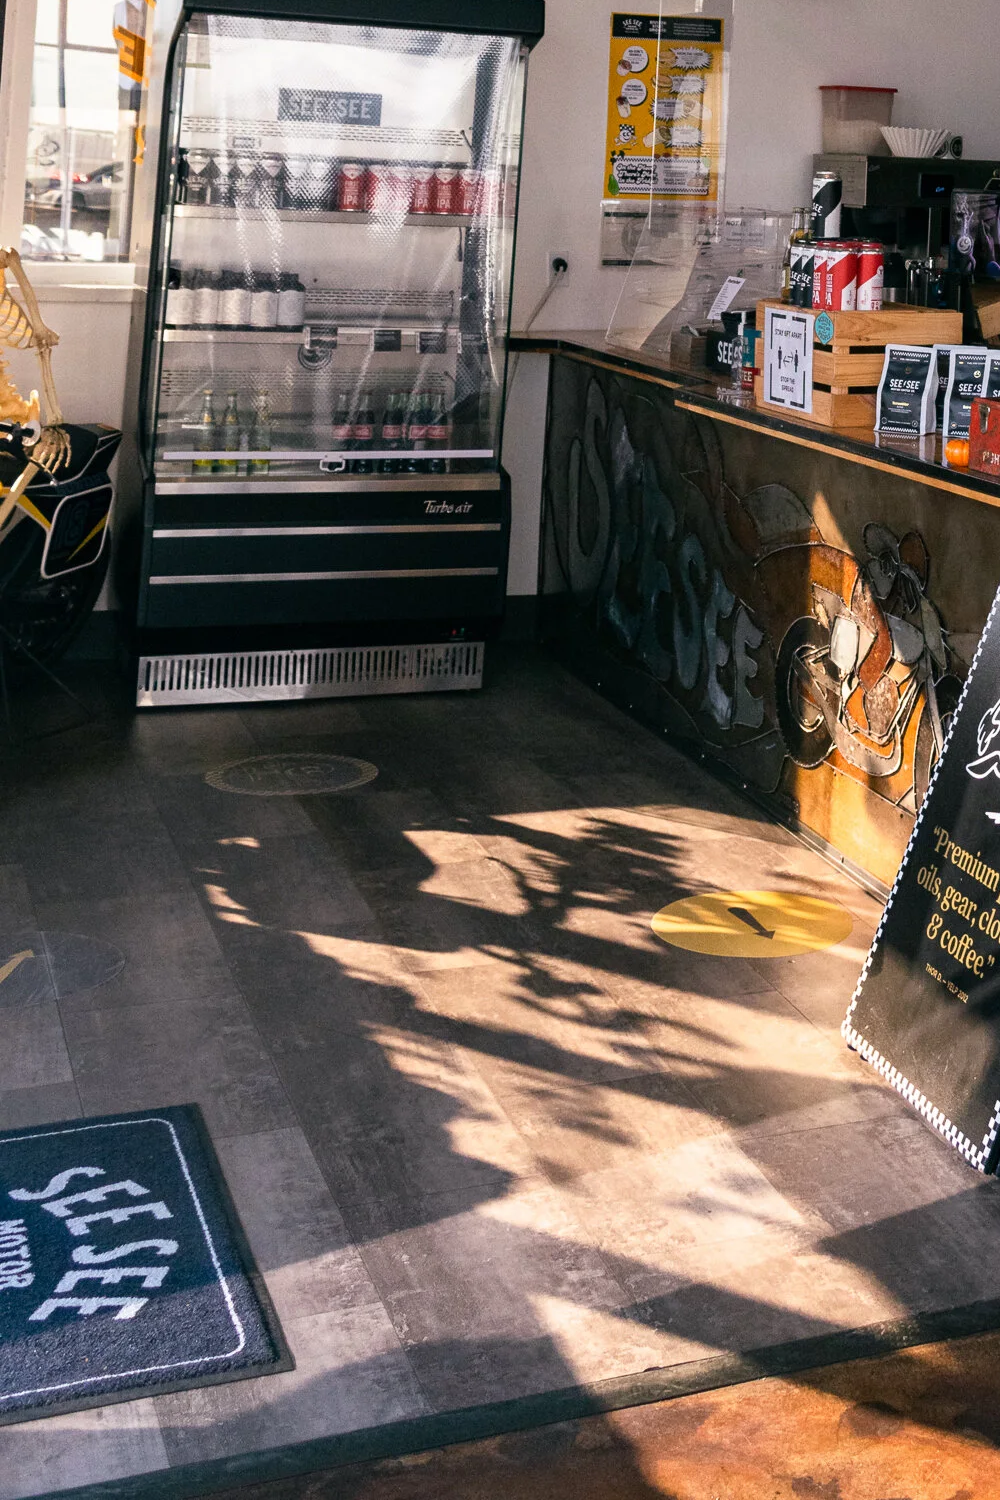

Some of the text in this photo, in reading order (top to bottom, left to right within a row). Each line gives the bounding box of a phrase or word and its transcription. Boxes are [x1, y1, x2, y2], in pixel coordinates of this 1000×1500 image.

[337, 99, 372, 119] SEE
[344, 195, 358, 205] IPA
[774, 329, 784, 337] STAY
[780, 376, 789, 384] STOP
[890, 379, 920, 390] SEE SEE
[781, 385, 794, 393] SPREAD
[958, 383, 973, 393] SEE
[423, 500, 473, 514] Turbo air
[917, 864, 942, 902] oils,
[940, 885, 977, 928] gear,
[926, 913, 943, 940] &
[8, 1166, 180, 1321] SEE SEE
